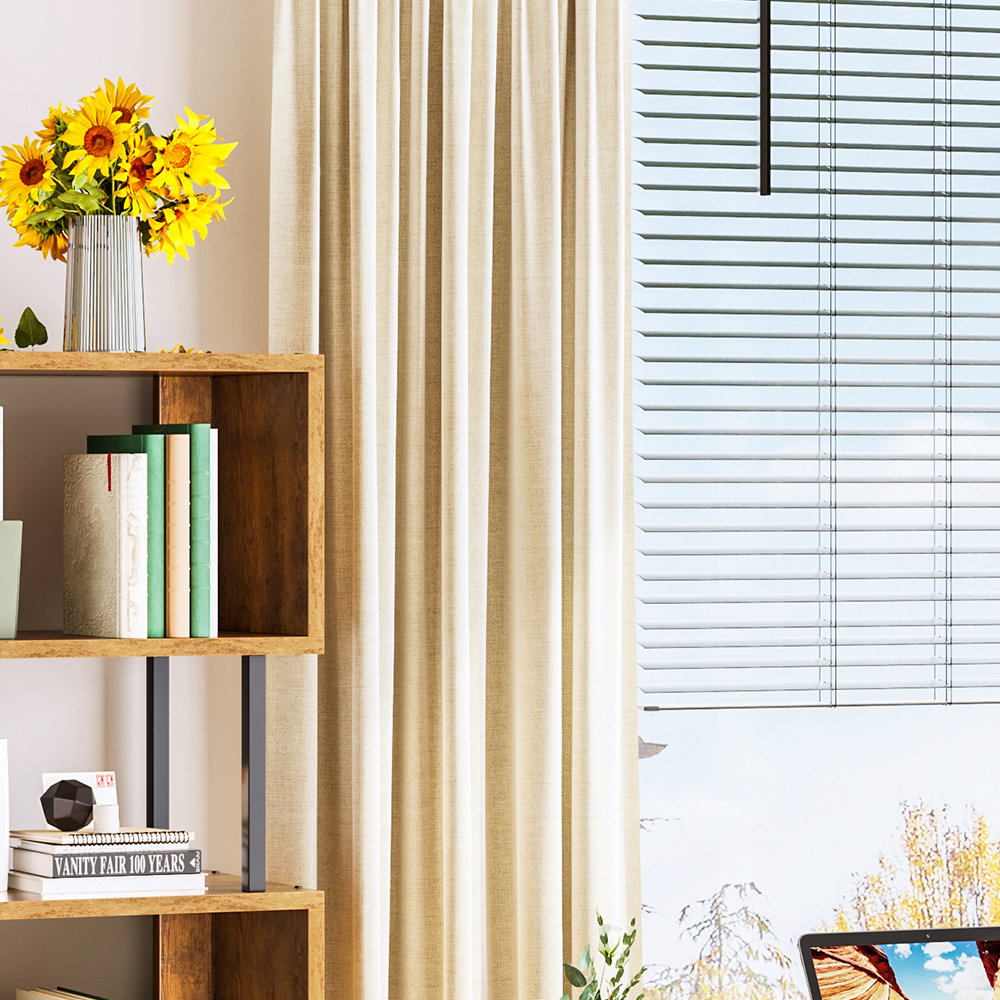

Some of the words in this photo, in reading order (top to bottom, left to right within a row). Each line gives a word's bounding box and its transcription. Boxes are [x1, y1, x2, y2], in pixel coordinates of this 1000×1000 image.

[54, 856, 98, 876] VANITY
[100, 855, 127, 875] FAIR
[130, 855, 146, 874] 100
[148, 853, 185, 874] YEARS
